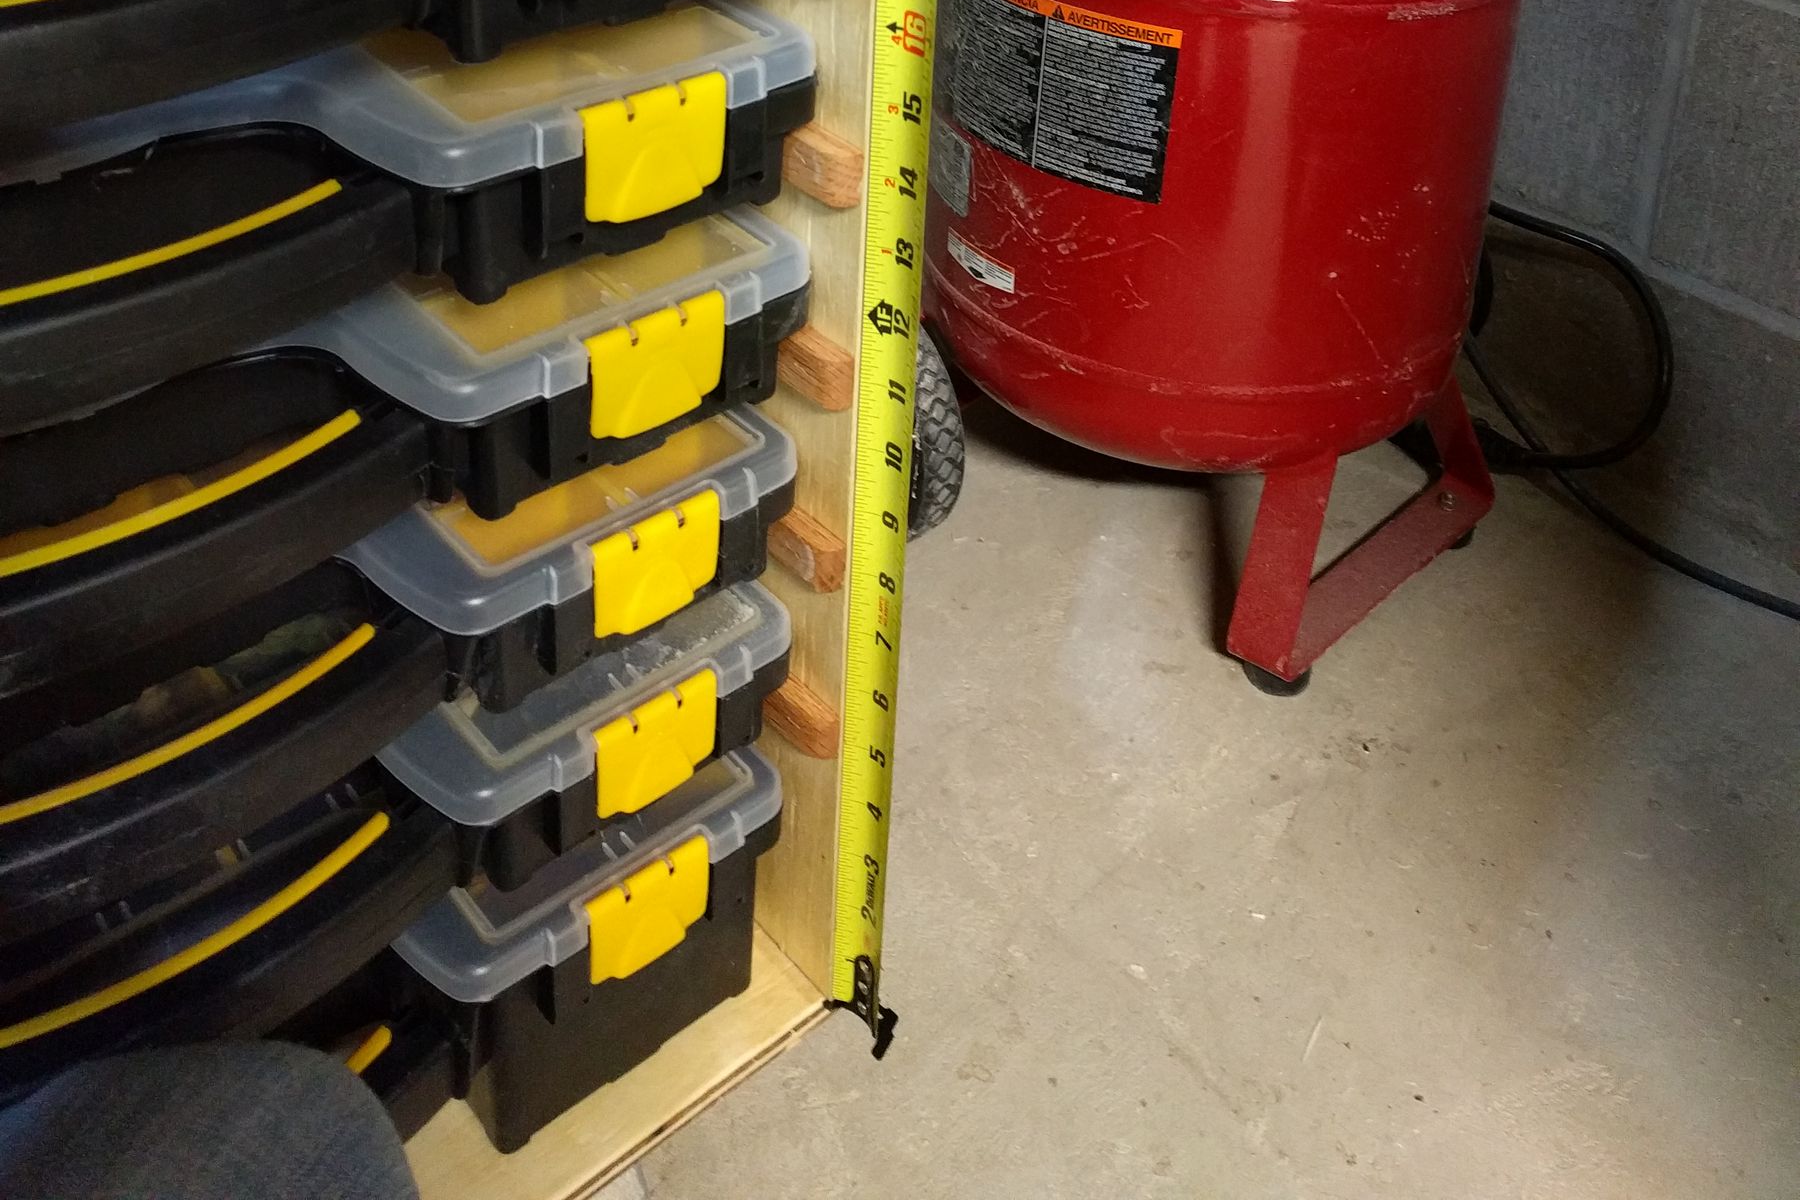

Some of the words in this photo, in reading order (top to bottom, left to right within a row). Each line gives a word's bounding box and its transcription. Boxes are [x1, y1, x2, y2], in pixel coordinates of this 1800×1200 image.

[903, 11, 926, 57] 16
[1067, 11, 1175, 45] AVERTISSEMENT
[891, 36, 902, 46] 4
[888, 104, 899, 115] 3
[903, 91, 922, 126] 15
[884, 178, 896, 188] 2
[899, 166, 918, 200] 14
[895, 238, 914, 271] 13
[893, 308, 911, 340] 12
[888, 379, 907, 405] 11
[885, 441, 903, 473] 10
[882, 510, 899, 534] 9
[879, 572, 896, 595] 8
[875, 631, 891, 651] 7
[873, 689, 889, 712] 6
[869, 745, 886, 768] 5
[867, 801, 882, 822] 4
[864, 854, 879, 875] 3
[861, 905, 877, 929] 2
